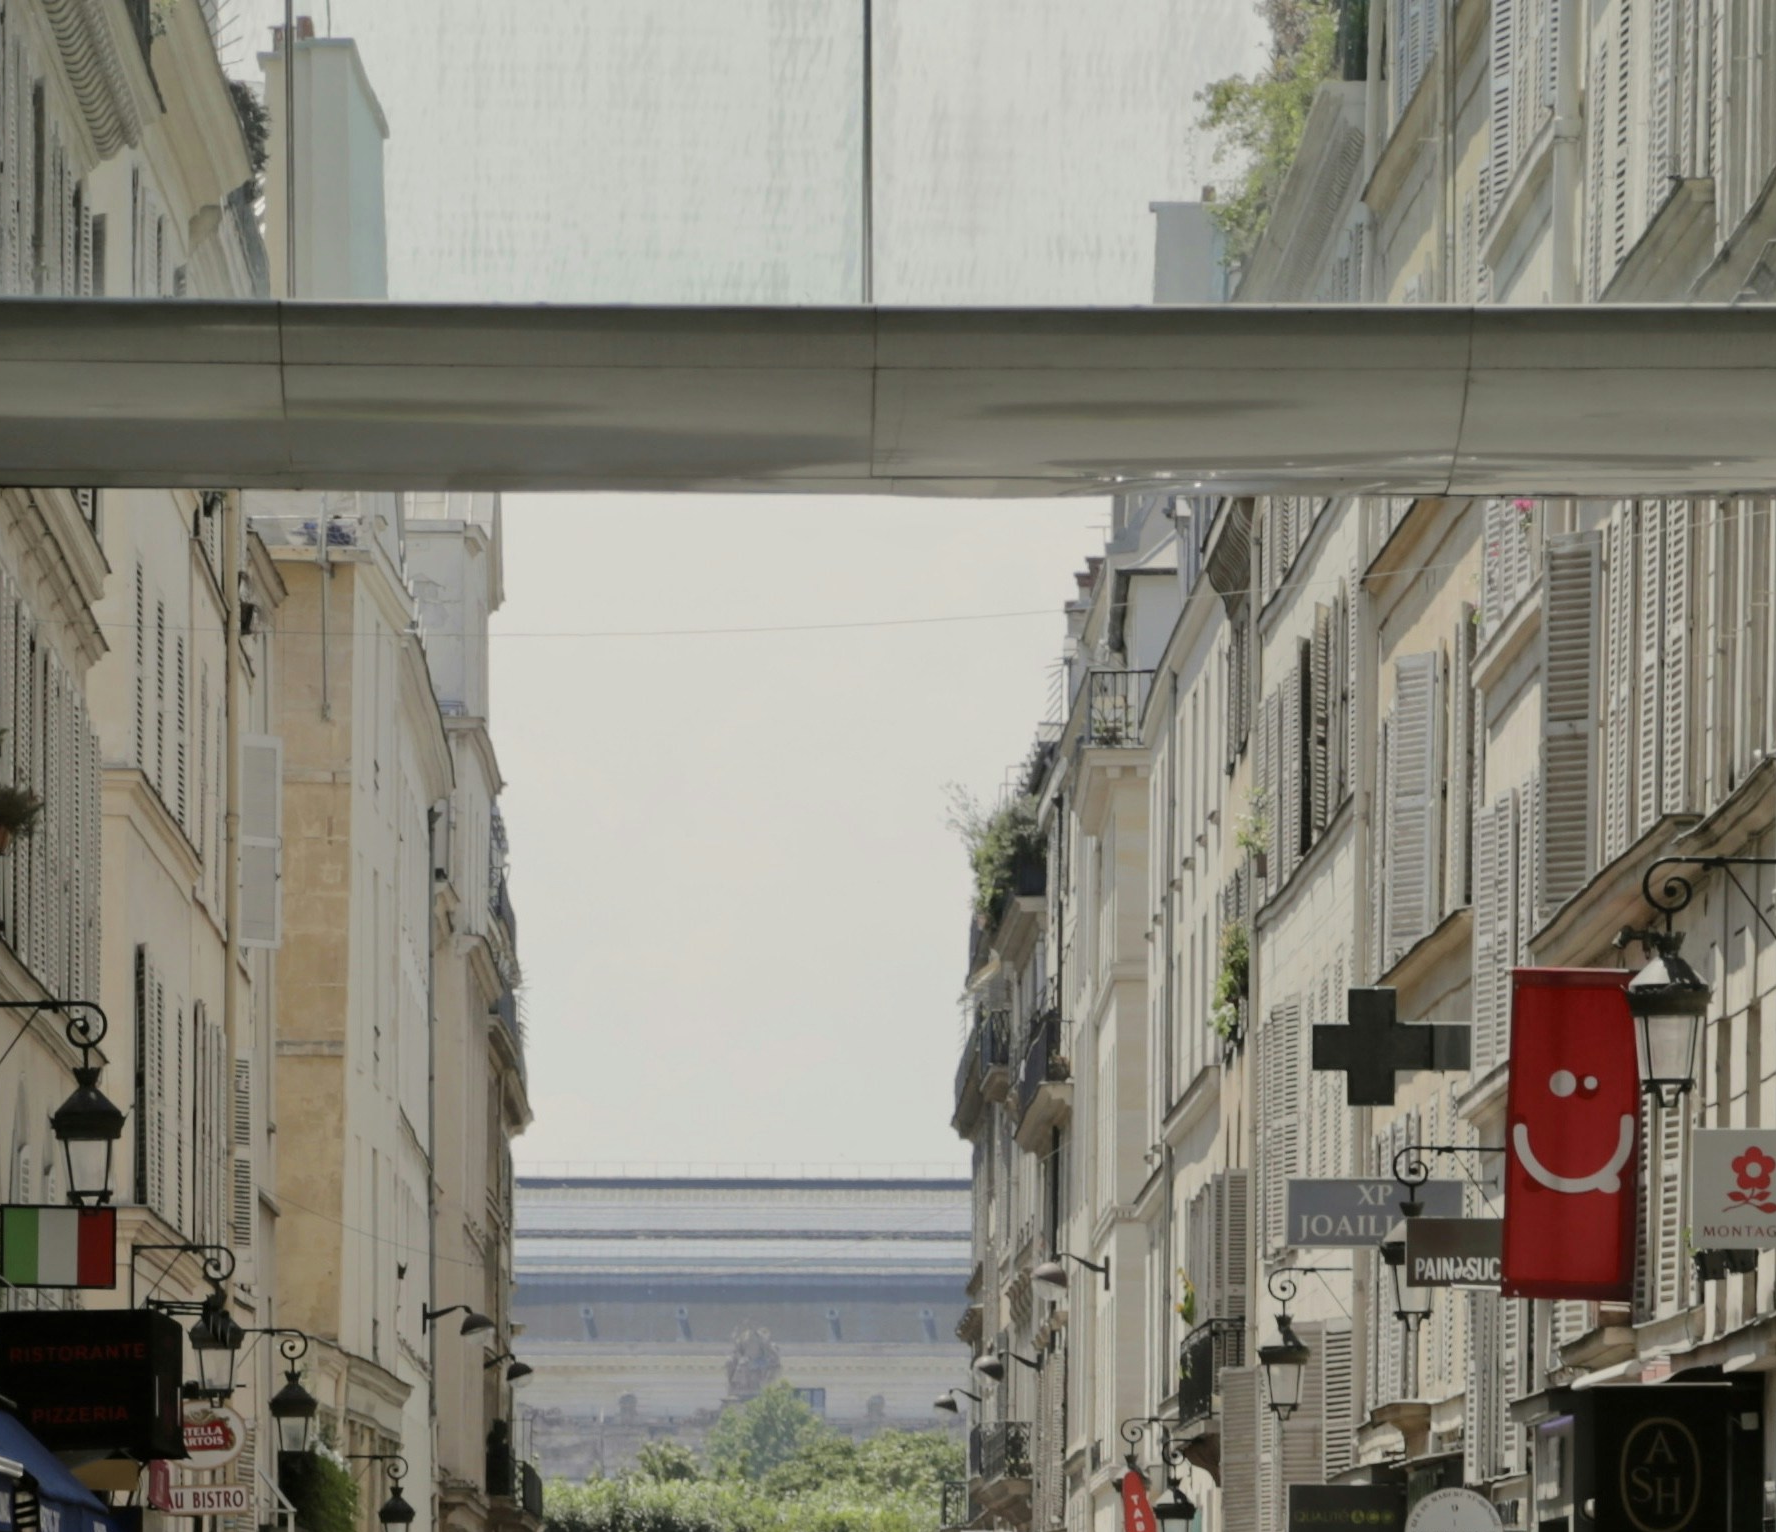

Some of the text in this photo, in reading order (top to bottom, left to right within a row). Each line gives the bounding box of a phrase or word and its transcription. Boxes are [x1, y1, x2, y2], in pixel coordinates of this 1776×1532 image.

[1358, 1184, 1393, 1206] XP
[8, 1343, 146, 1362] RISTORANTE
[31, 1406, 130, 1424] PIZZERIA
[193, 1490, 245, 1509] BISTRO
